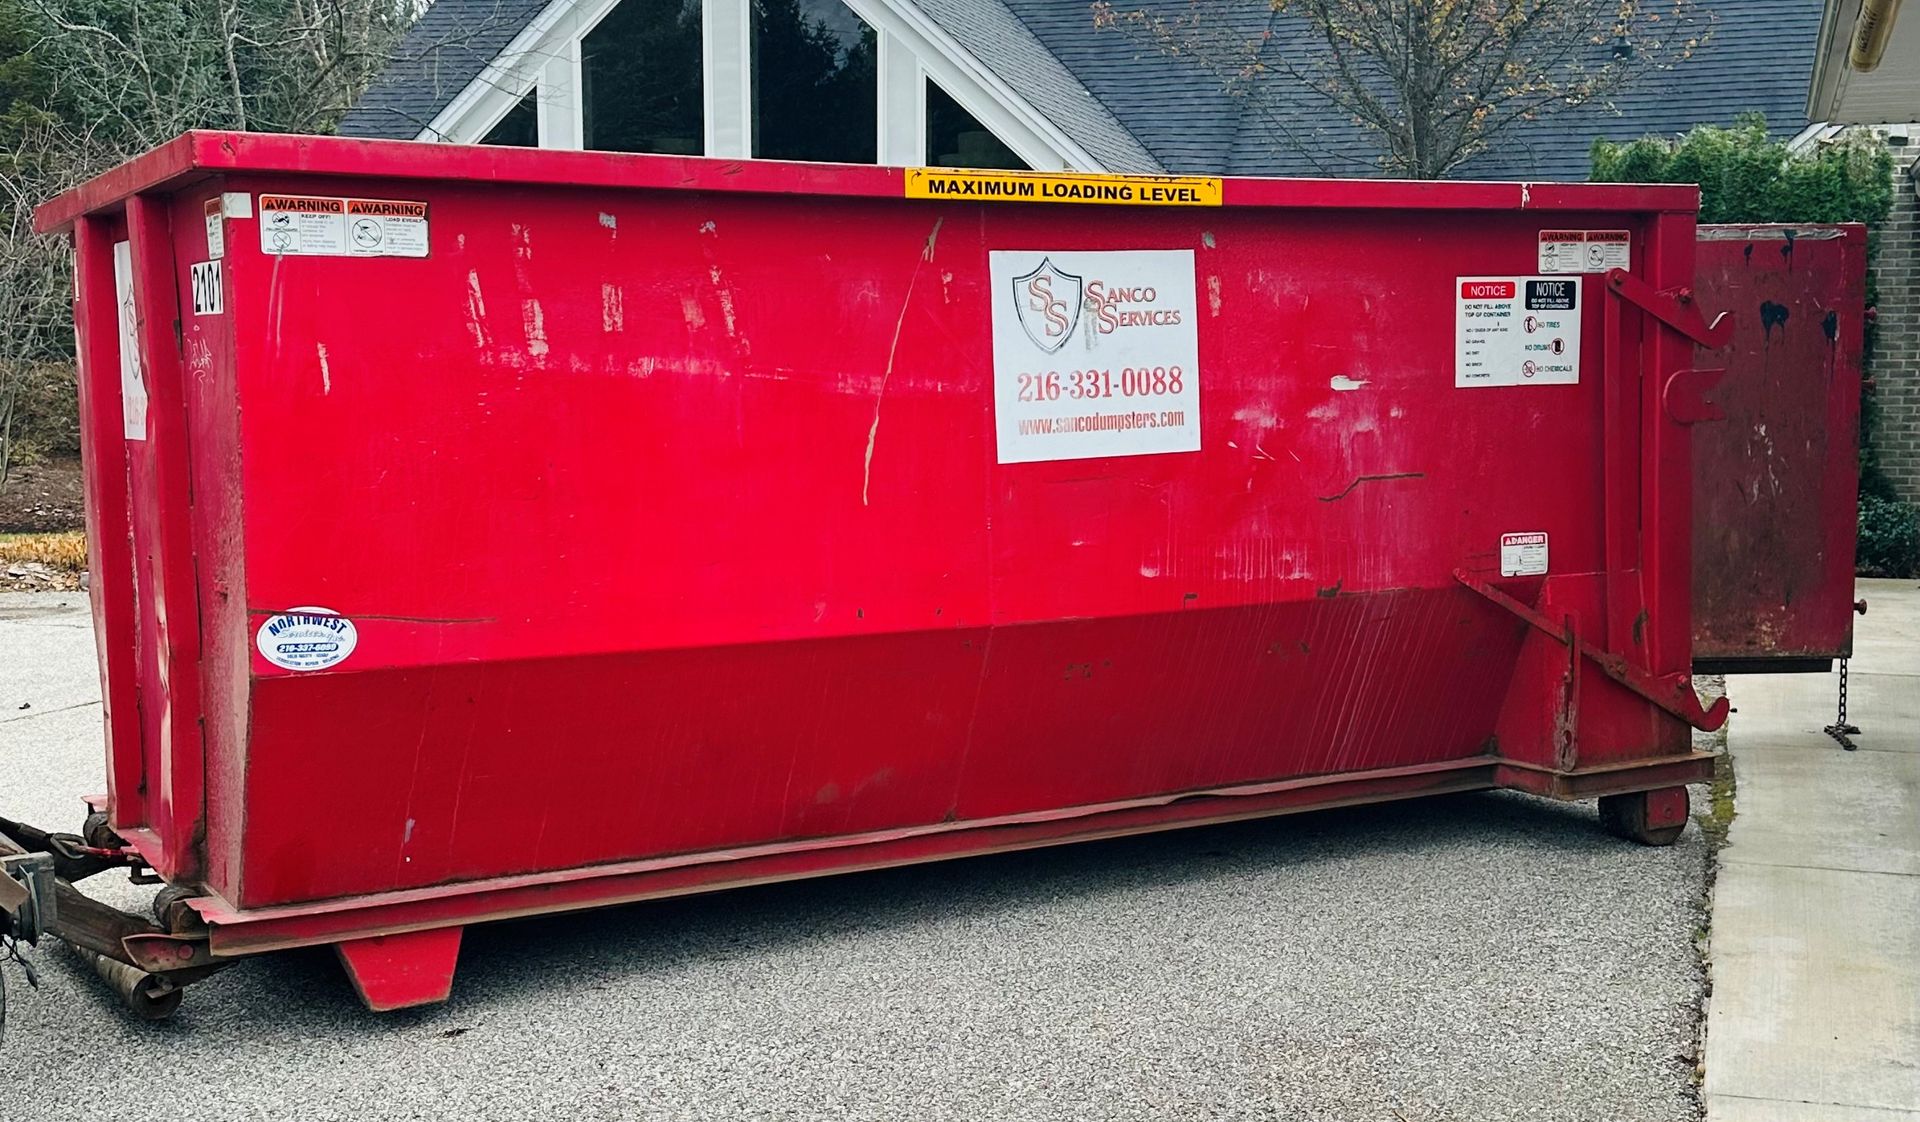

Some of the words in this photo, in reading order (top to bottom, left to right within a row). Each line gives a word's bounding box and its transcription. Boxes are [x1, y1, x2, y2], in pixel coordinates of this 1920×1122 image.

[928, 179, 1033, 197] MAXIMUM
[1042, 182, 1133, 201] LOADING
[1140, 186, 1201, 202] LEVEL
[275, 199, 340, 212] WARNING
[361, 203, 423, 216] WARNING
[1548, 232, 1583, 241] WARNING
[1593, 232, 1628, 241] WARNING
[193, 263, 221, 313] 2101
[1083, 279, 1157, 311] SANCO
[1471, 285, 1507, 297] NOTICE
[1536, 282, 1566, 297] NOTICE
[1098, 302, 1182, 334] SERVICES
[1017, 365, 1184, 402] 216-331-0088
[1018, 410, 1185, 436] www.sancodumpsters.com
[1511, 536, 1544, 544] DANGER
[268, 615, 348, 636] NORTHWEST
